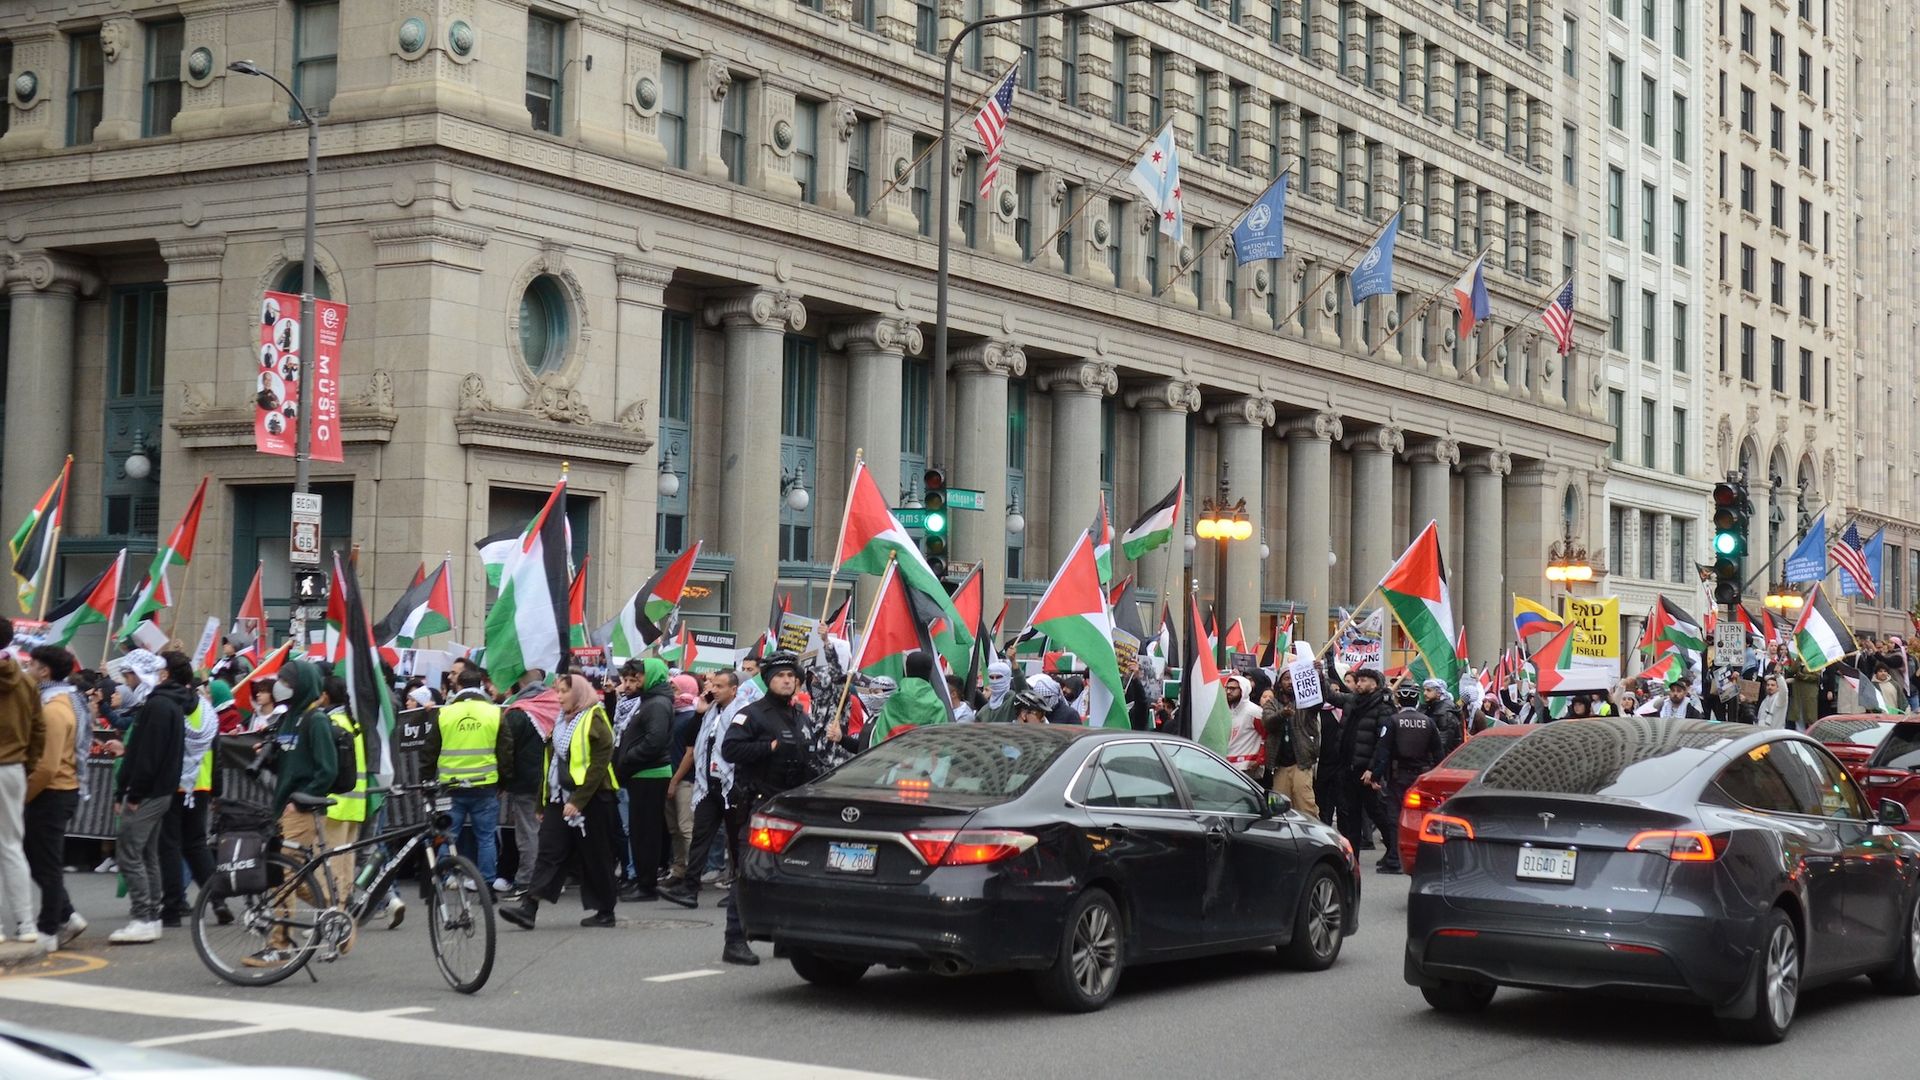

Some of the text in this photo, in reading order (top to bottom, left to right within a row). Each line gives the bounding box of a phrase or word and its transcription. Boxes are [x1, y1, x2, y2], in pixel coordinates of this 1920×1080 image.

[1242, 241, 1276, 251] NATIONAL
[1249, 247, 1268, 255] LOUIS
[317, 355, 331, 441] MUSIC
[296, 497, 318, 510] BEGIN
[895, 511, 919, 523] dams
[299, 536, 312, 548] 66
[1572, 602, 1604, 617] END
[1575, 618, 1602, 631] ALL
[1719, 625, 1742, 633] TURN
[696, 634, 734, 645] FREE PALESTINE
[1719, 634, 1740, 642] LEFT
[1346, 641, 1380, 653] STOP
[1575, 646, 1606, 657] ISRAEL
[1294, 668, 1315, 681] CEASE
[1296, 676, 1318, 690] FIRE
[1298, 686, 1319, 700] NOW
[459, 722, 482, 732] AMP
[1399, 718, 1427, 729] POLICE
[403, 723, 420, 739] by
[840, 841, 868, 850] ELGIN
[216, 857, 257, 873] POLICE
[1561, 859, 1573, 875] EL
